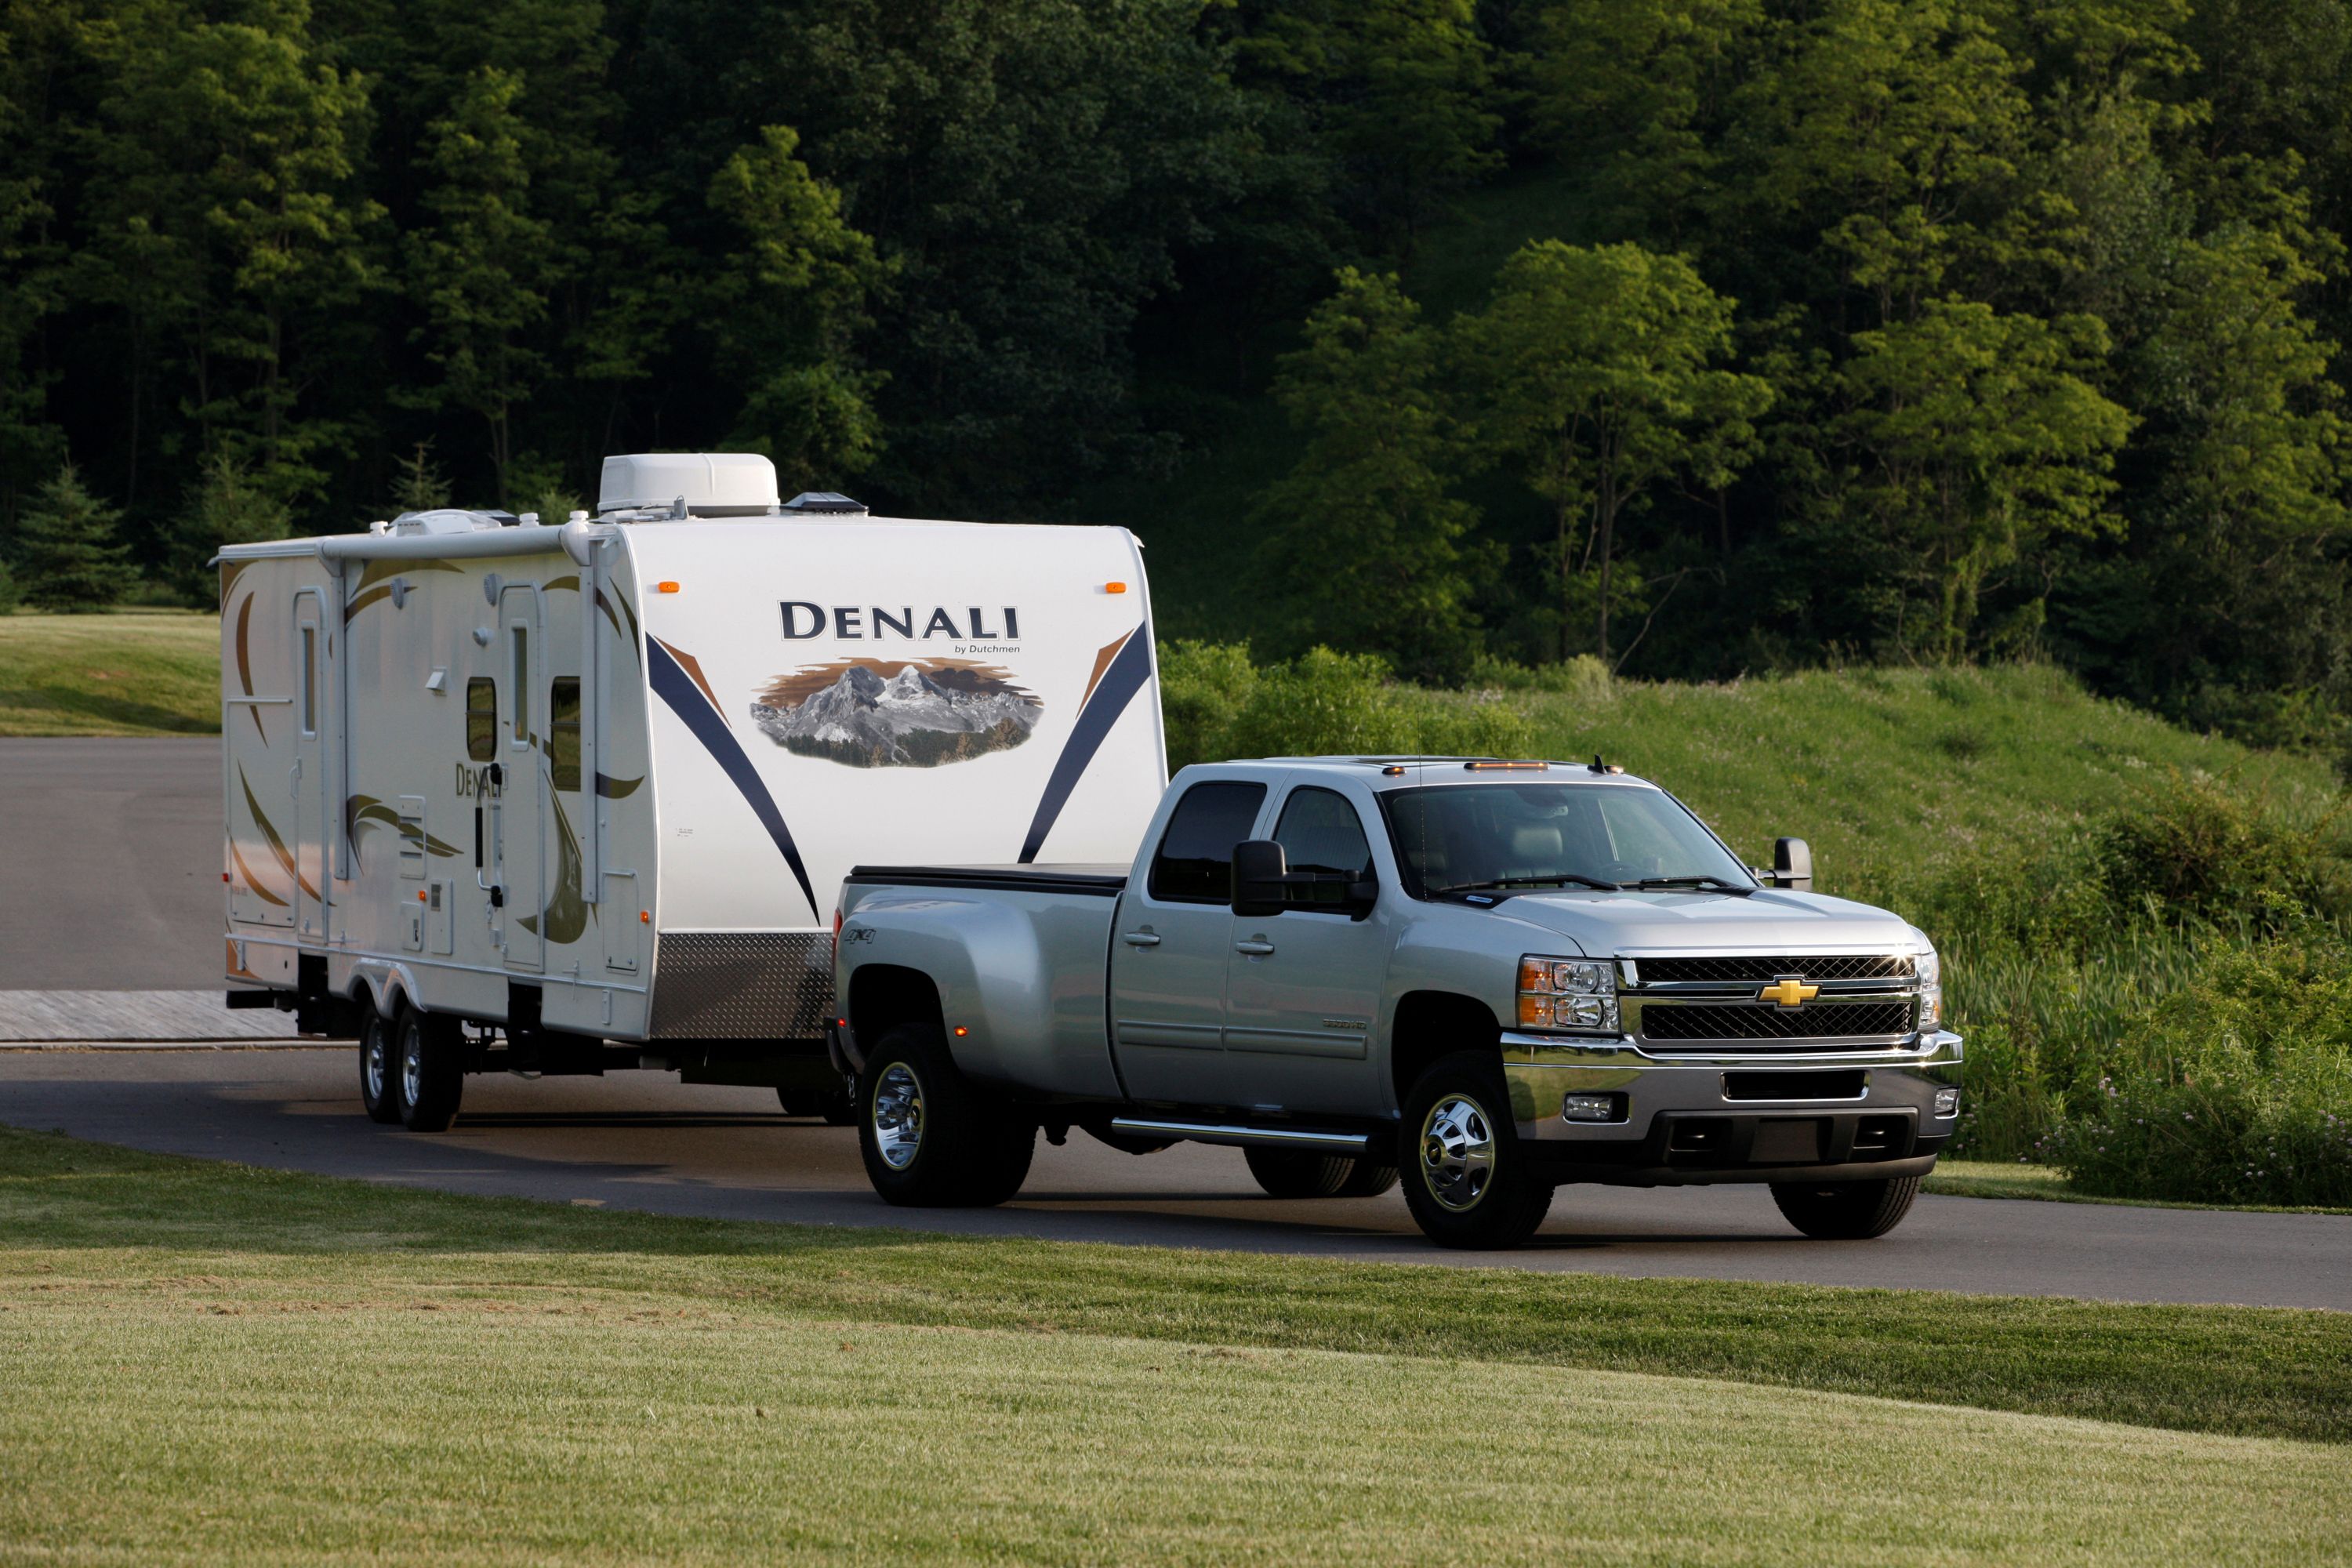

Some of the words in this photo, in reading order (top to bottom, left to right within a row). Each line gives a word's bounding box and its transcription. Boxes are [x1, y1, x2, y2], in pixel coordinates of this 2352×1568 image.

[777, 600, 1022, 641] DENALI
[954, 644, 966, 655] by
[969, 644, 1020, 653] Dutchmen
